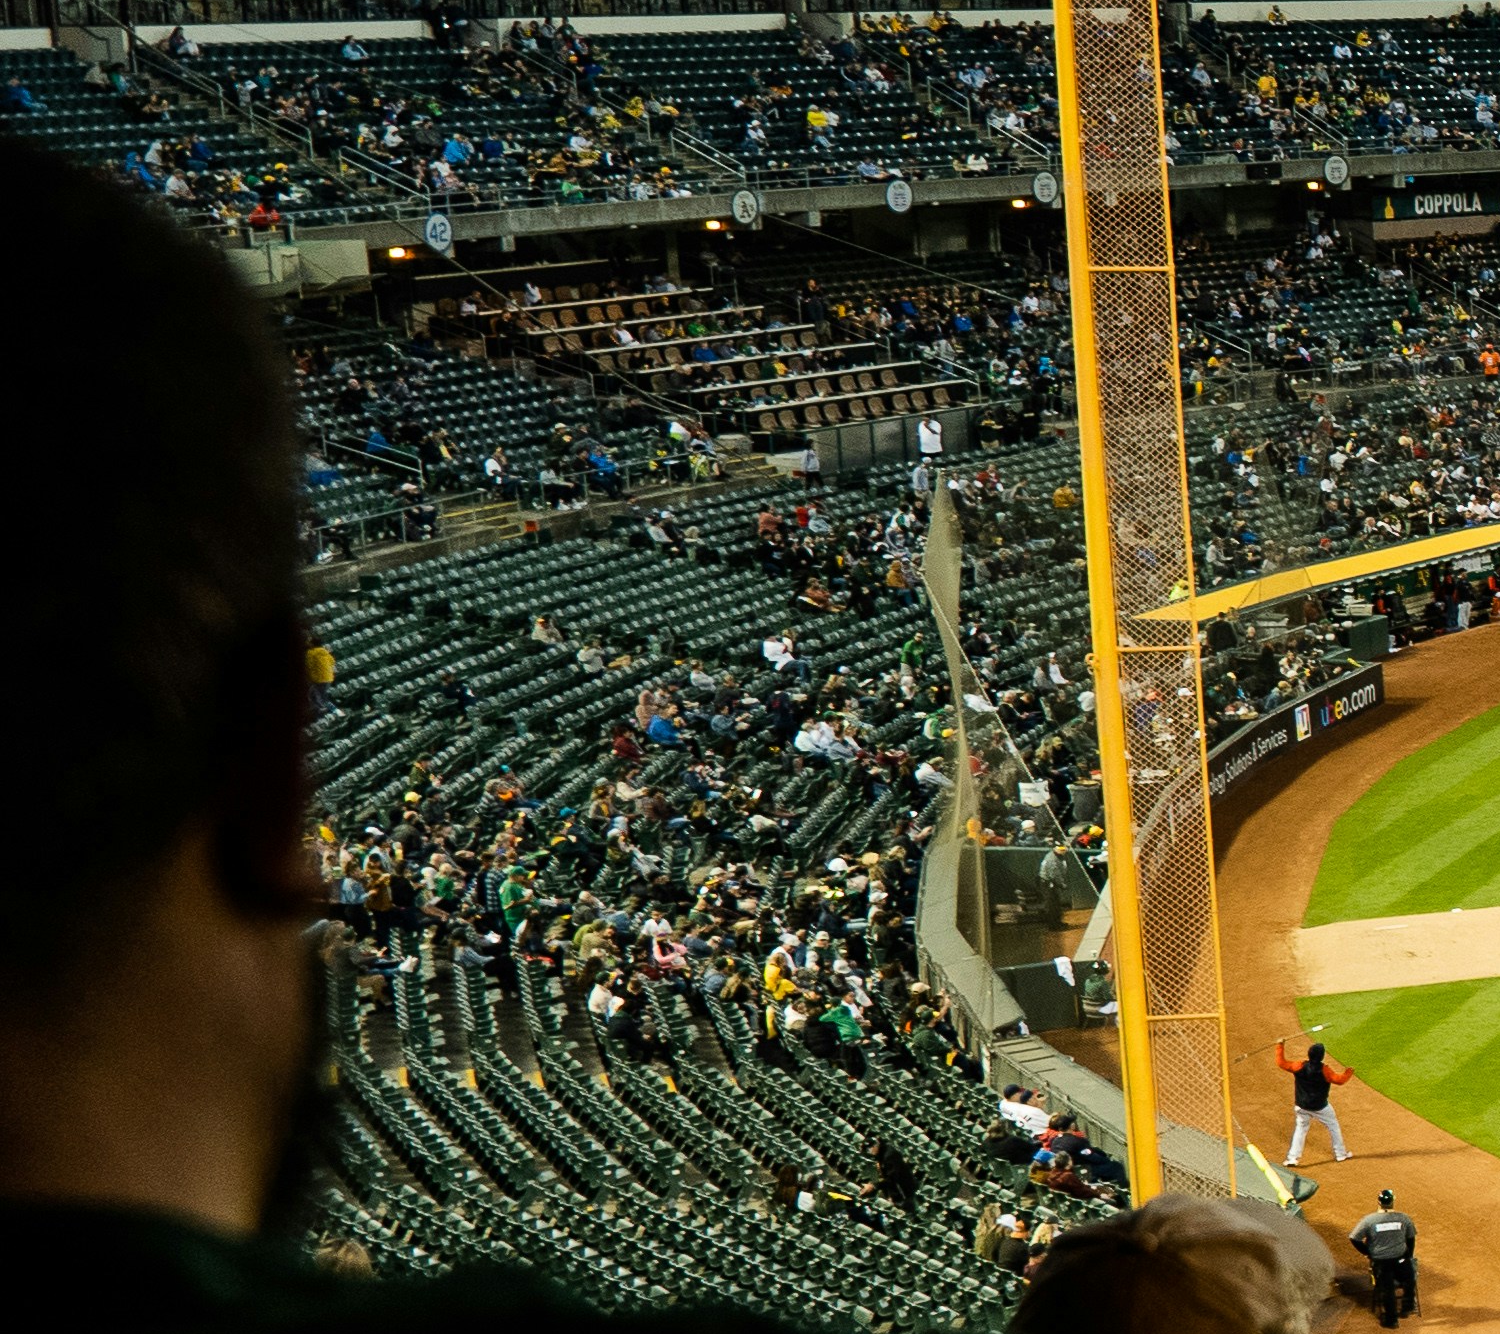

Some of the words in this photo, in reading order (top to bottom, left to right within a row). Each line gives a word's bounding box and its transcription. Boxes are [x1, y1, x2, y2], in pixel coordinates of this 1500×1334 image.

[1414, 192, 1482, 215] COPPOLA
[429, 223, 449, 244] 42
[1320, 683, 1377, 727] ubeo.com
[1226, 748, 1253, 783] Solutions
[1257, 727, 1288, 761] Services
